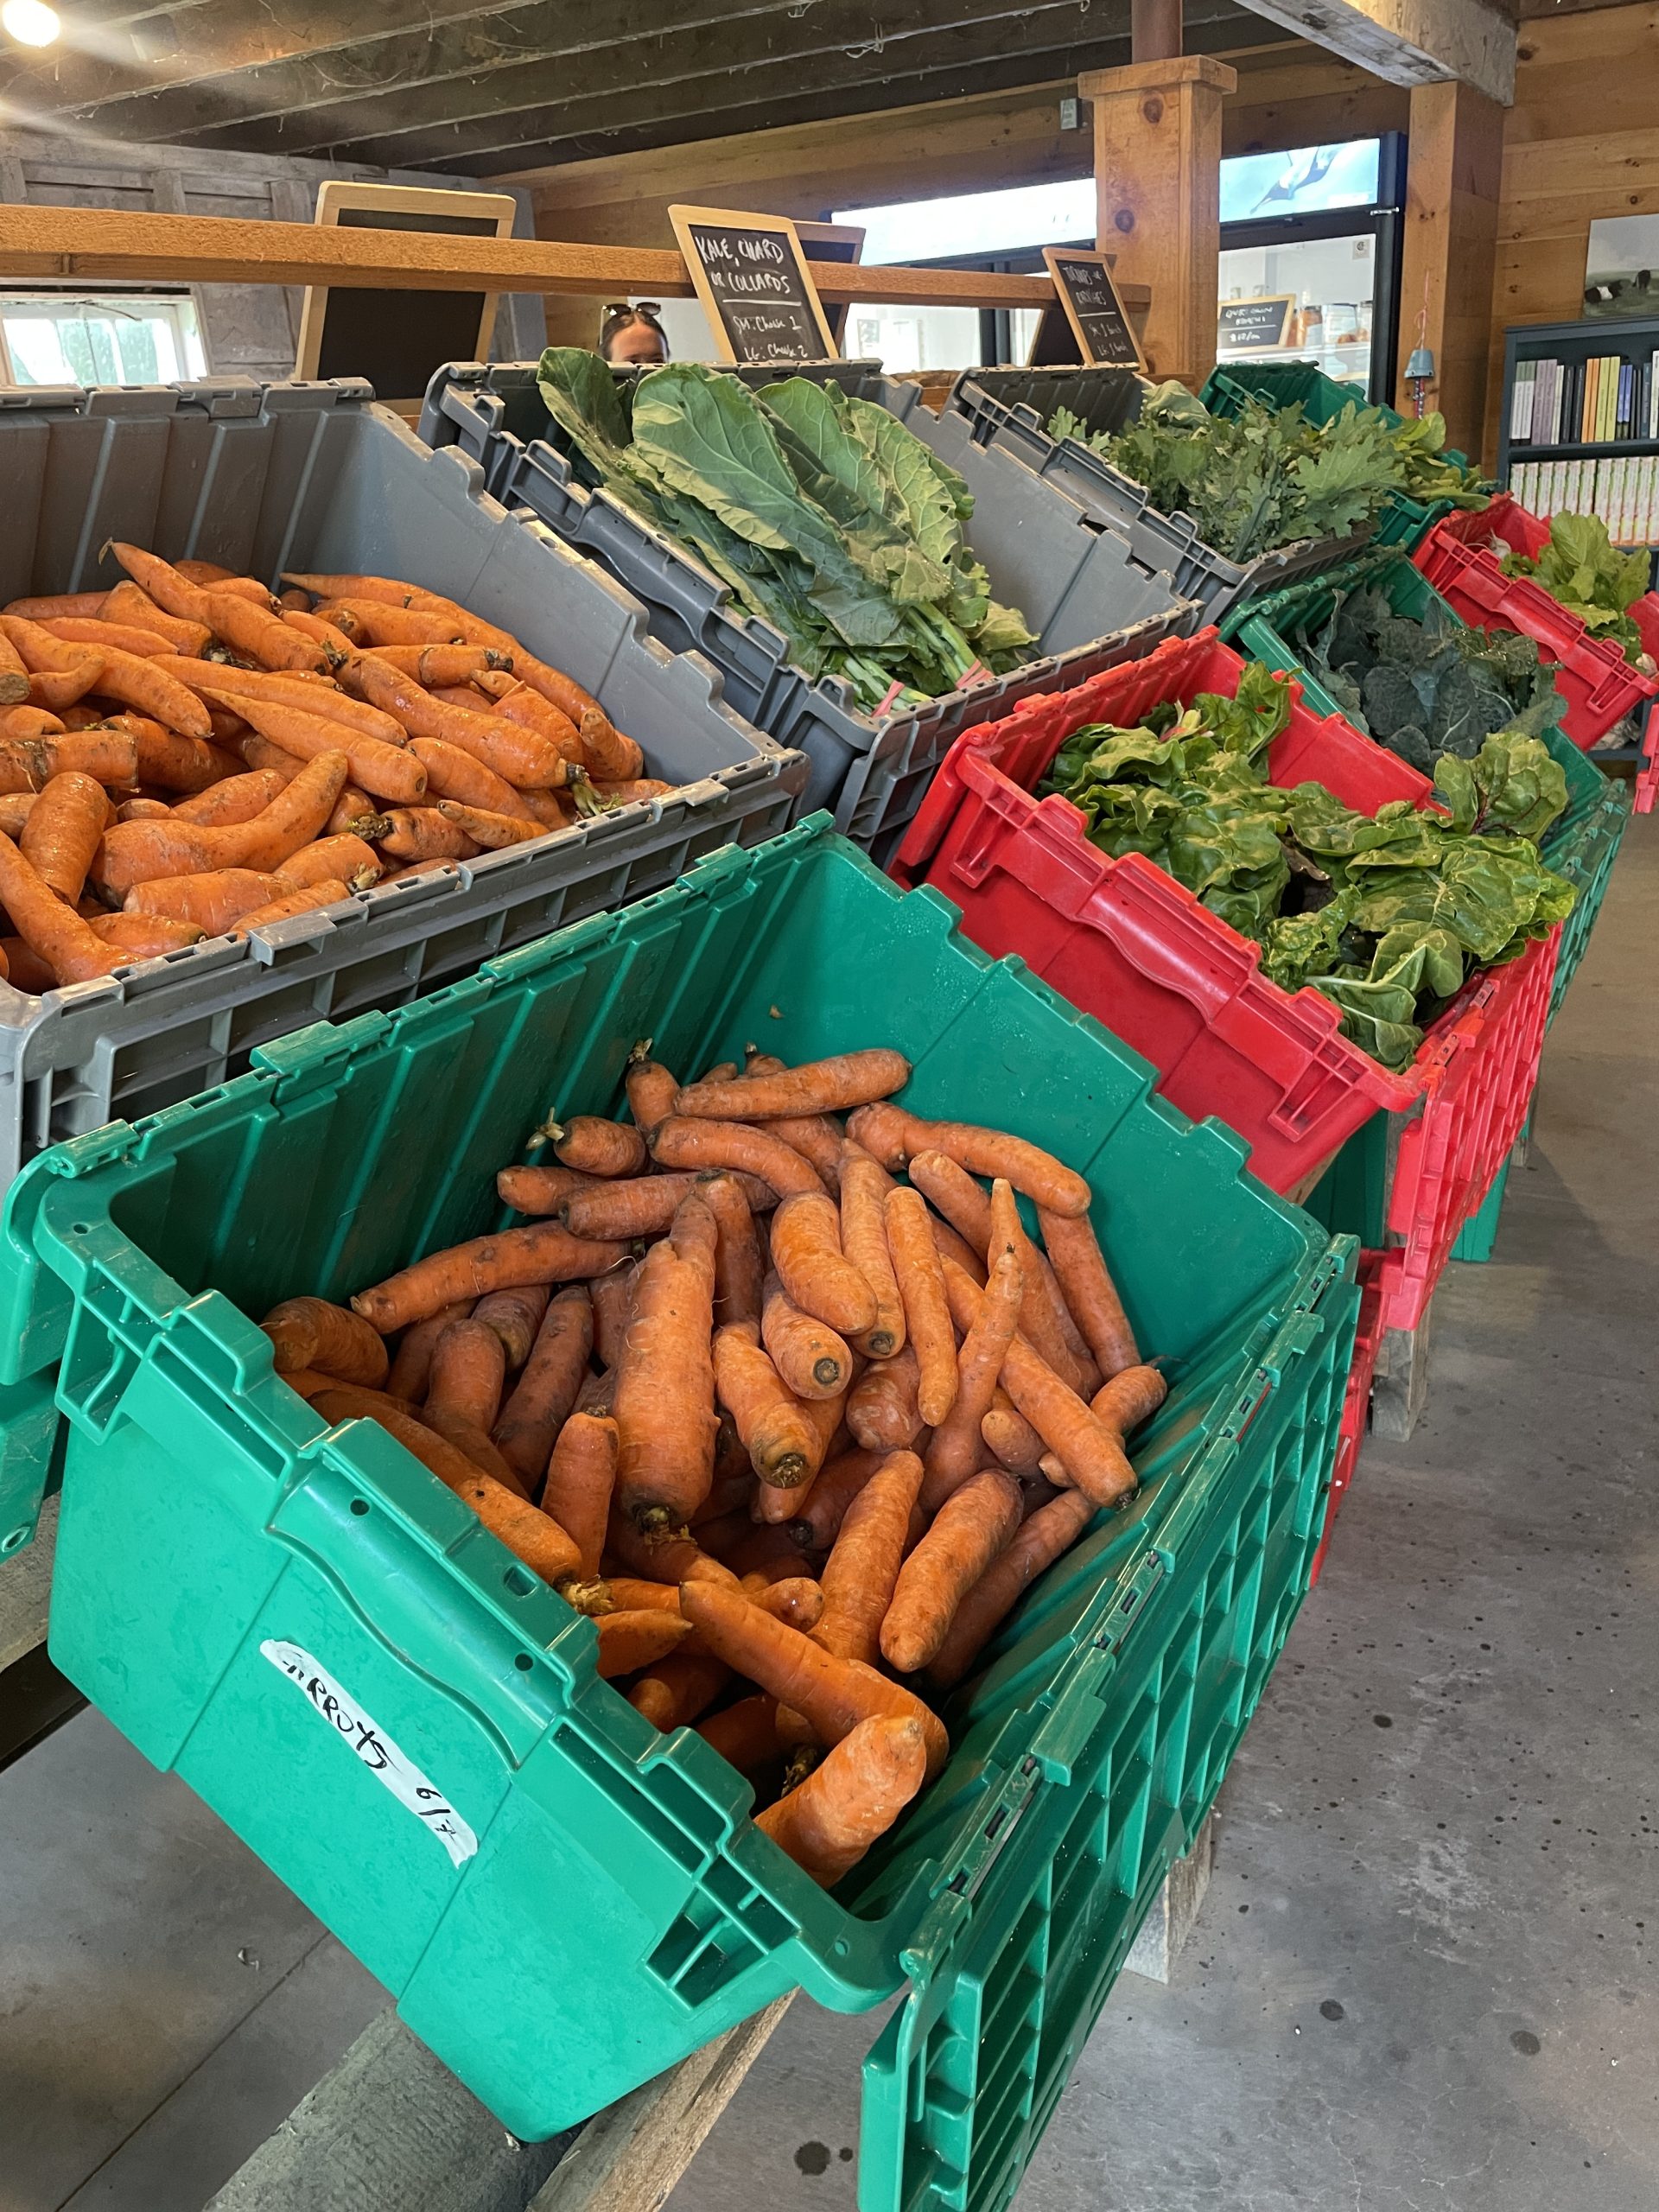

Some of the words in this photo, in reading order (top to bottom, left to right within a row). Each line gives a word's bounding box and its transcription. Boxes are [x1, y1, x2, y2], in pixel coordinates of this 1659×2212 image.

[737, 238, 784, 264] CHARD
[710, 271, 725, 288] OR
[728, 271, 791, 295] COLLARDS
[797, 344, 809, 358] 2
